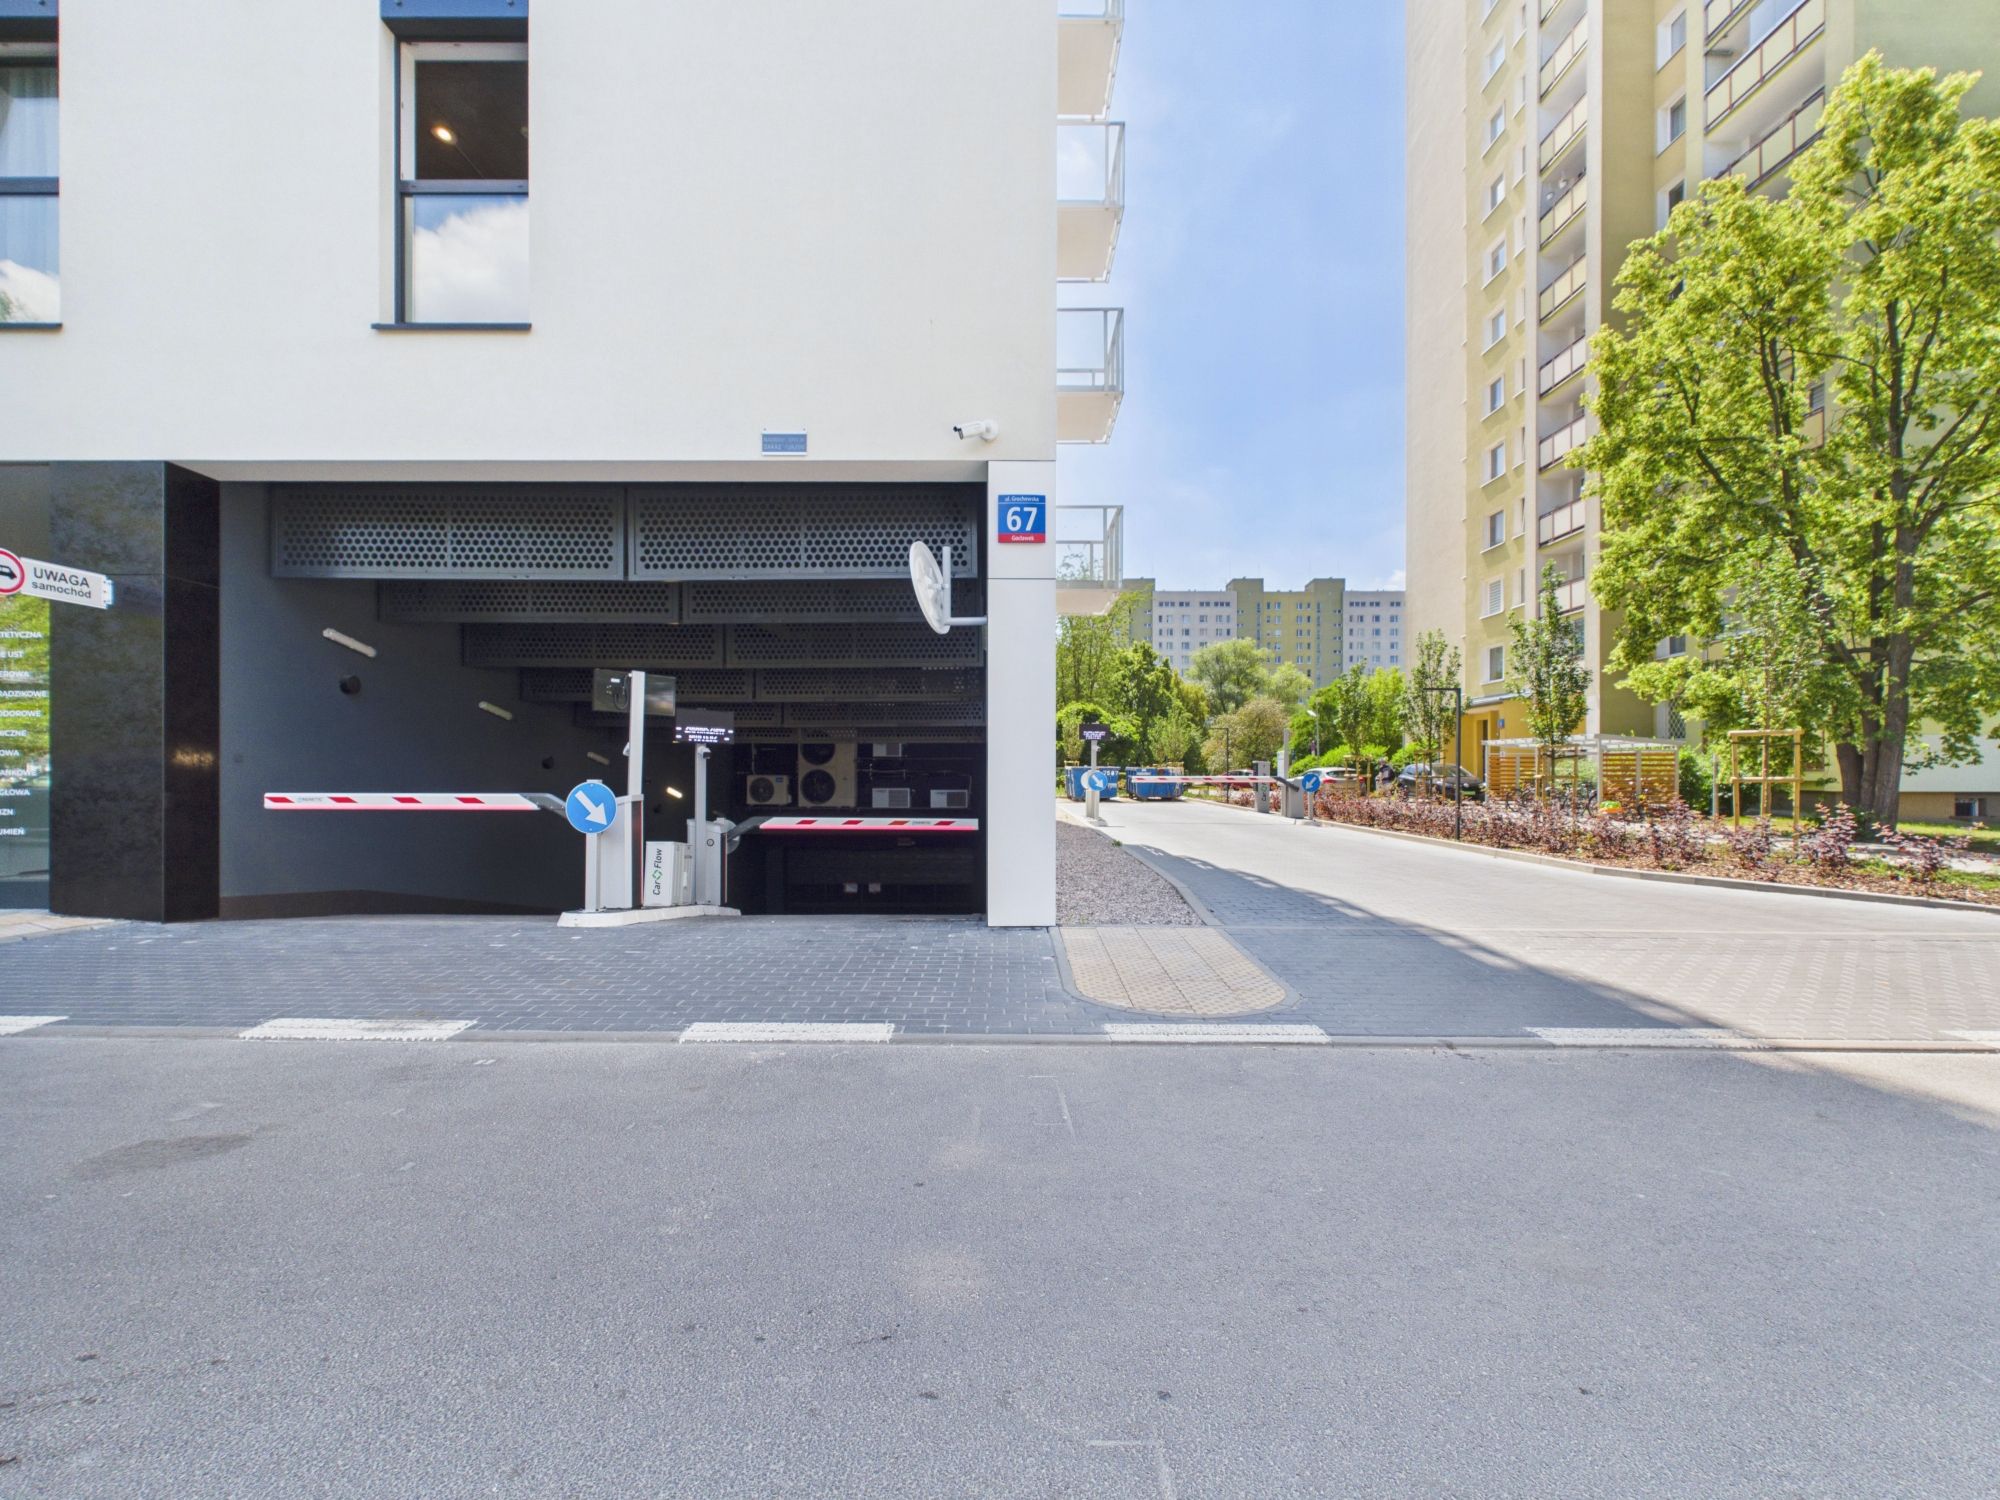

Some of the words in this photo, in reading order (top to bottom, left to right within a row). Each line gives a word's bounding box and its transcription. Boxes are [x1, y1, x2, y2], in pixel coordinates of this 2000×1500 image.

[1006, 506, 1038, 532] 67
[33, 567, 90, 588] UWAGA
[31, 580, 92, 599] samochód
[8, 650, 24, 658] UST
[654, 848, 662, 869] Flow
[652, 880, 661, 896] Car
